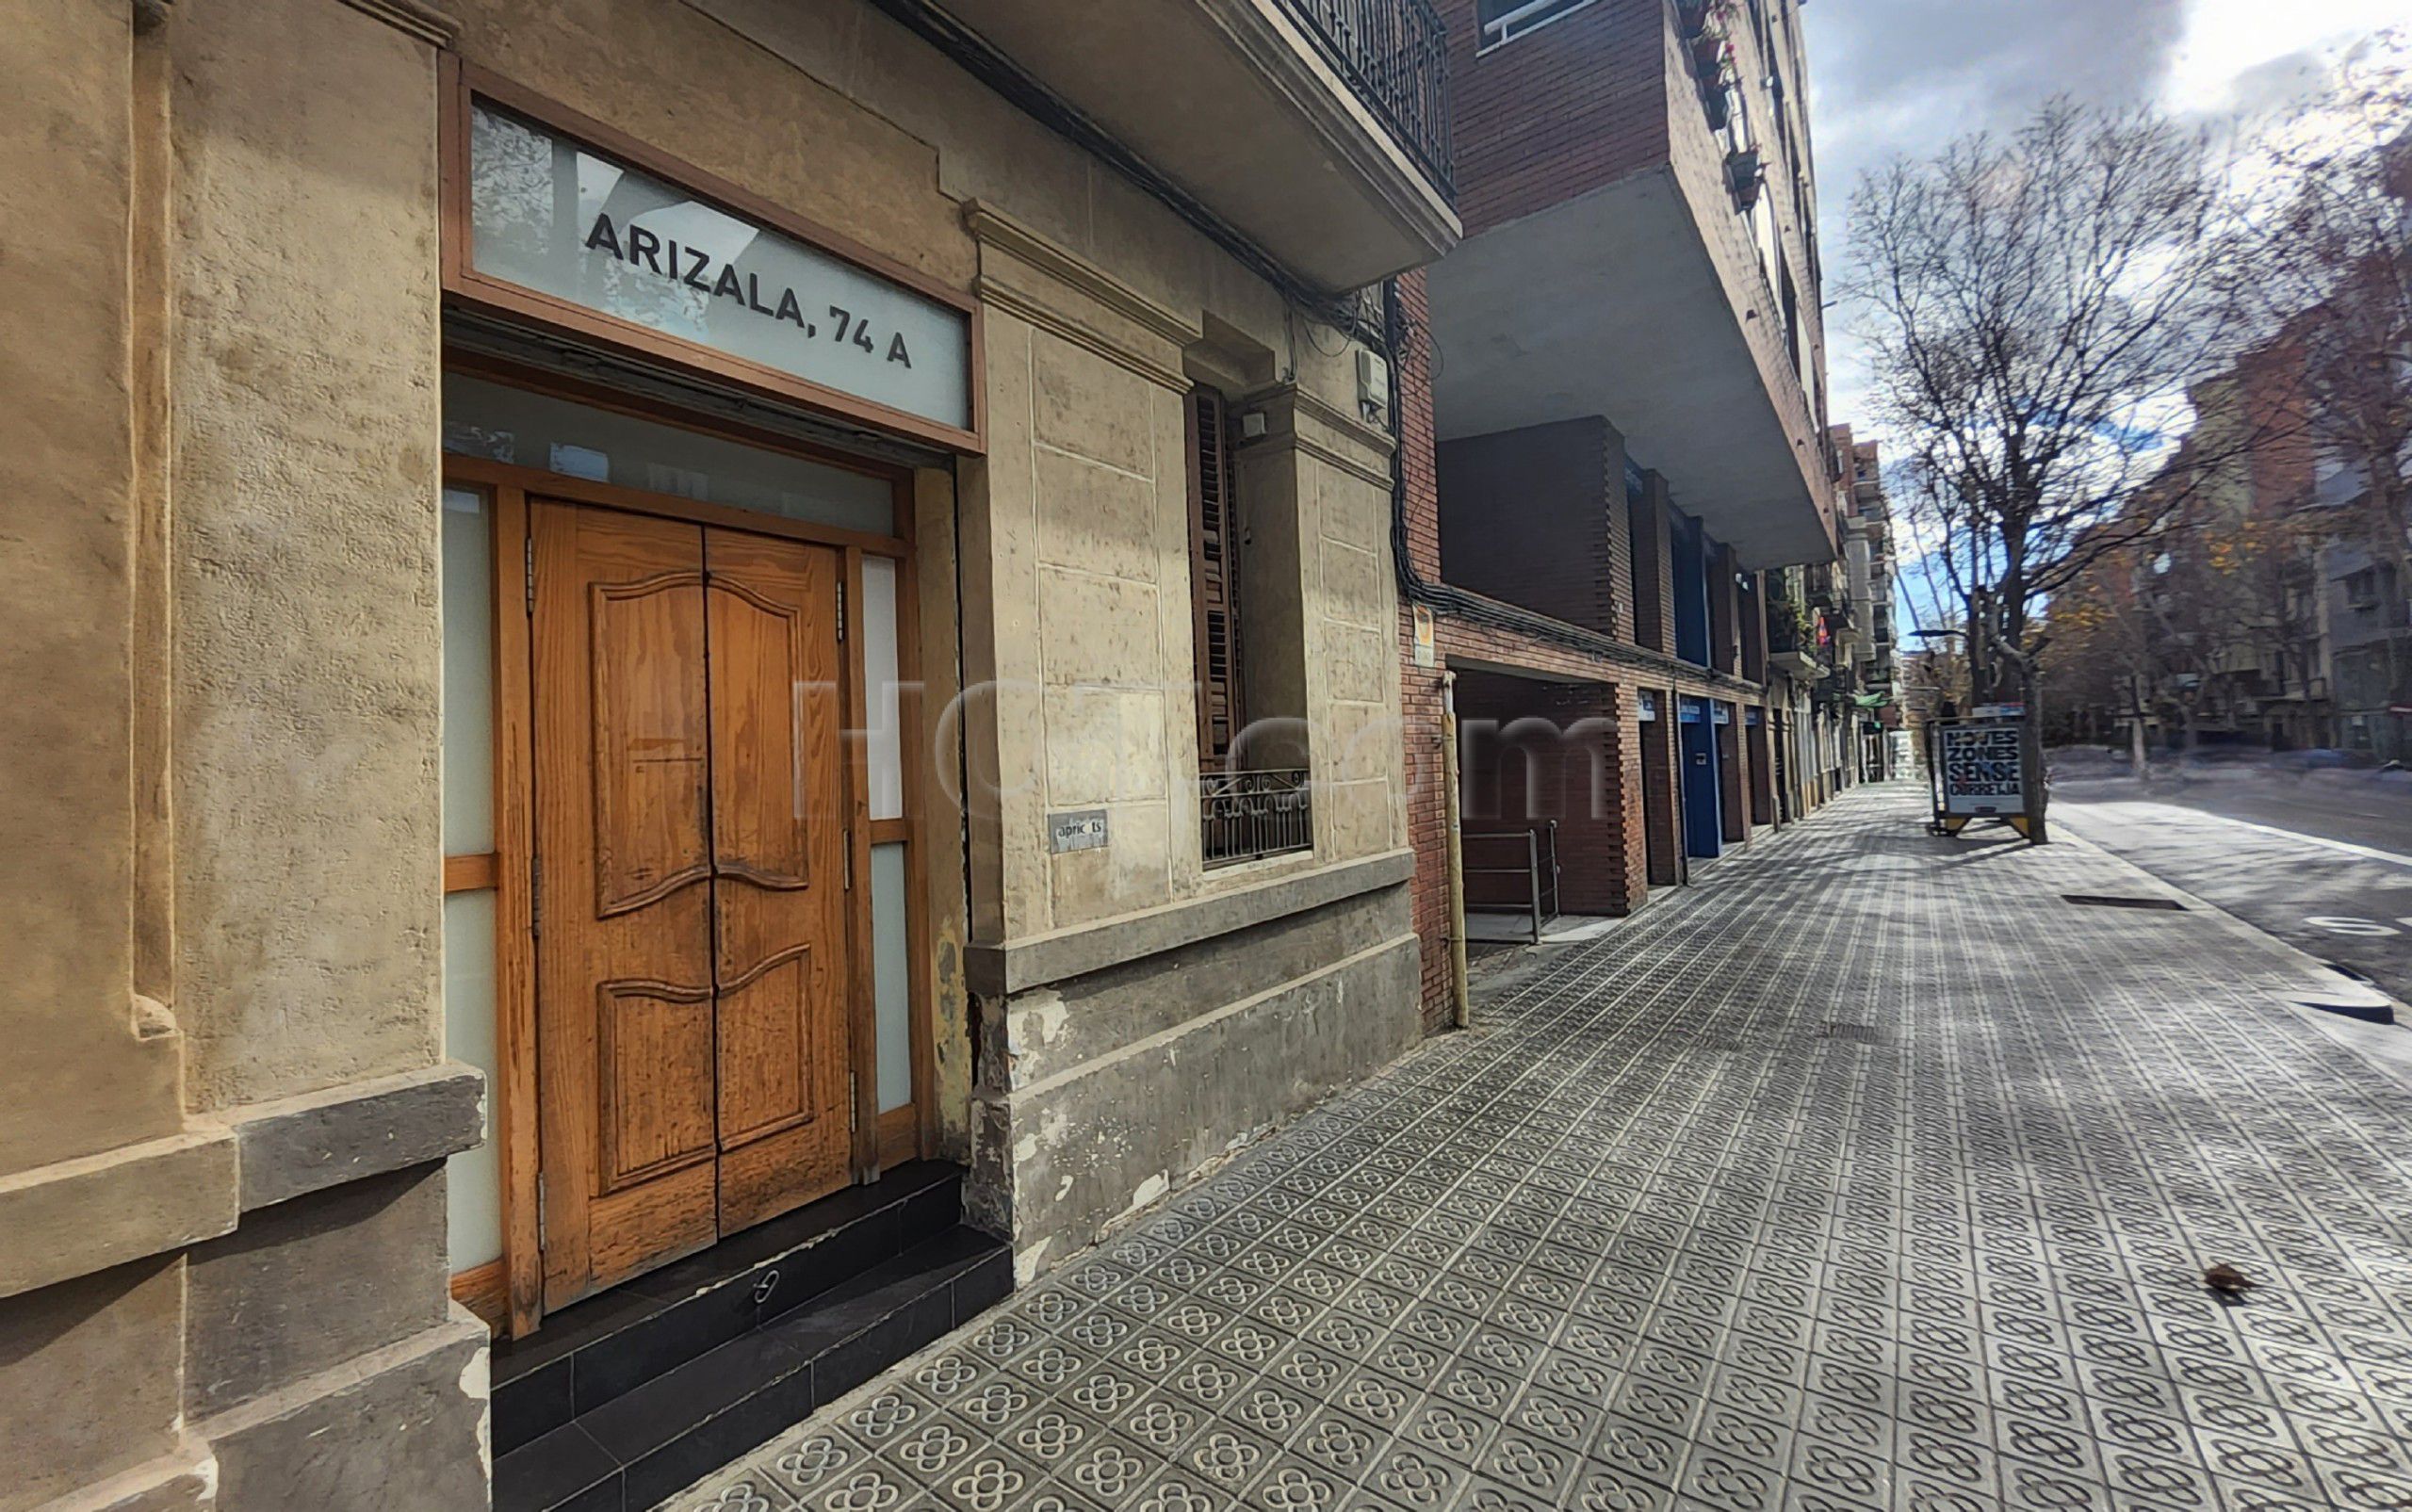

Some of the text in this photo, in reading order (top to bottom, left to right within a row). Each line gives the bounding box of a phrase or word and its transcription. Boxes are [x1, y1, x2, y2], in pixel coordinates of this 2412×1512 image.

[584, 212, 912, 369] ARIZALA, 74 A
[1947, 730, 2017, 746] NOVES
[1948, 746, 2018, 761] ZONES
[1948, 761, 2019, 781] SENSE
